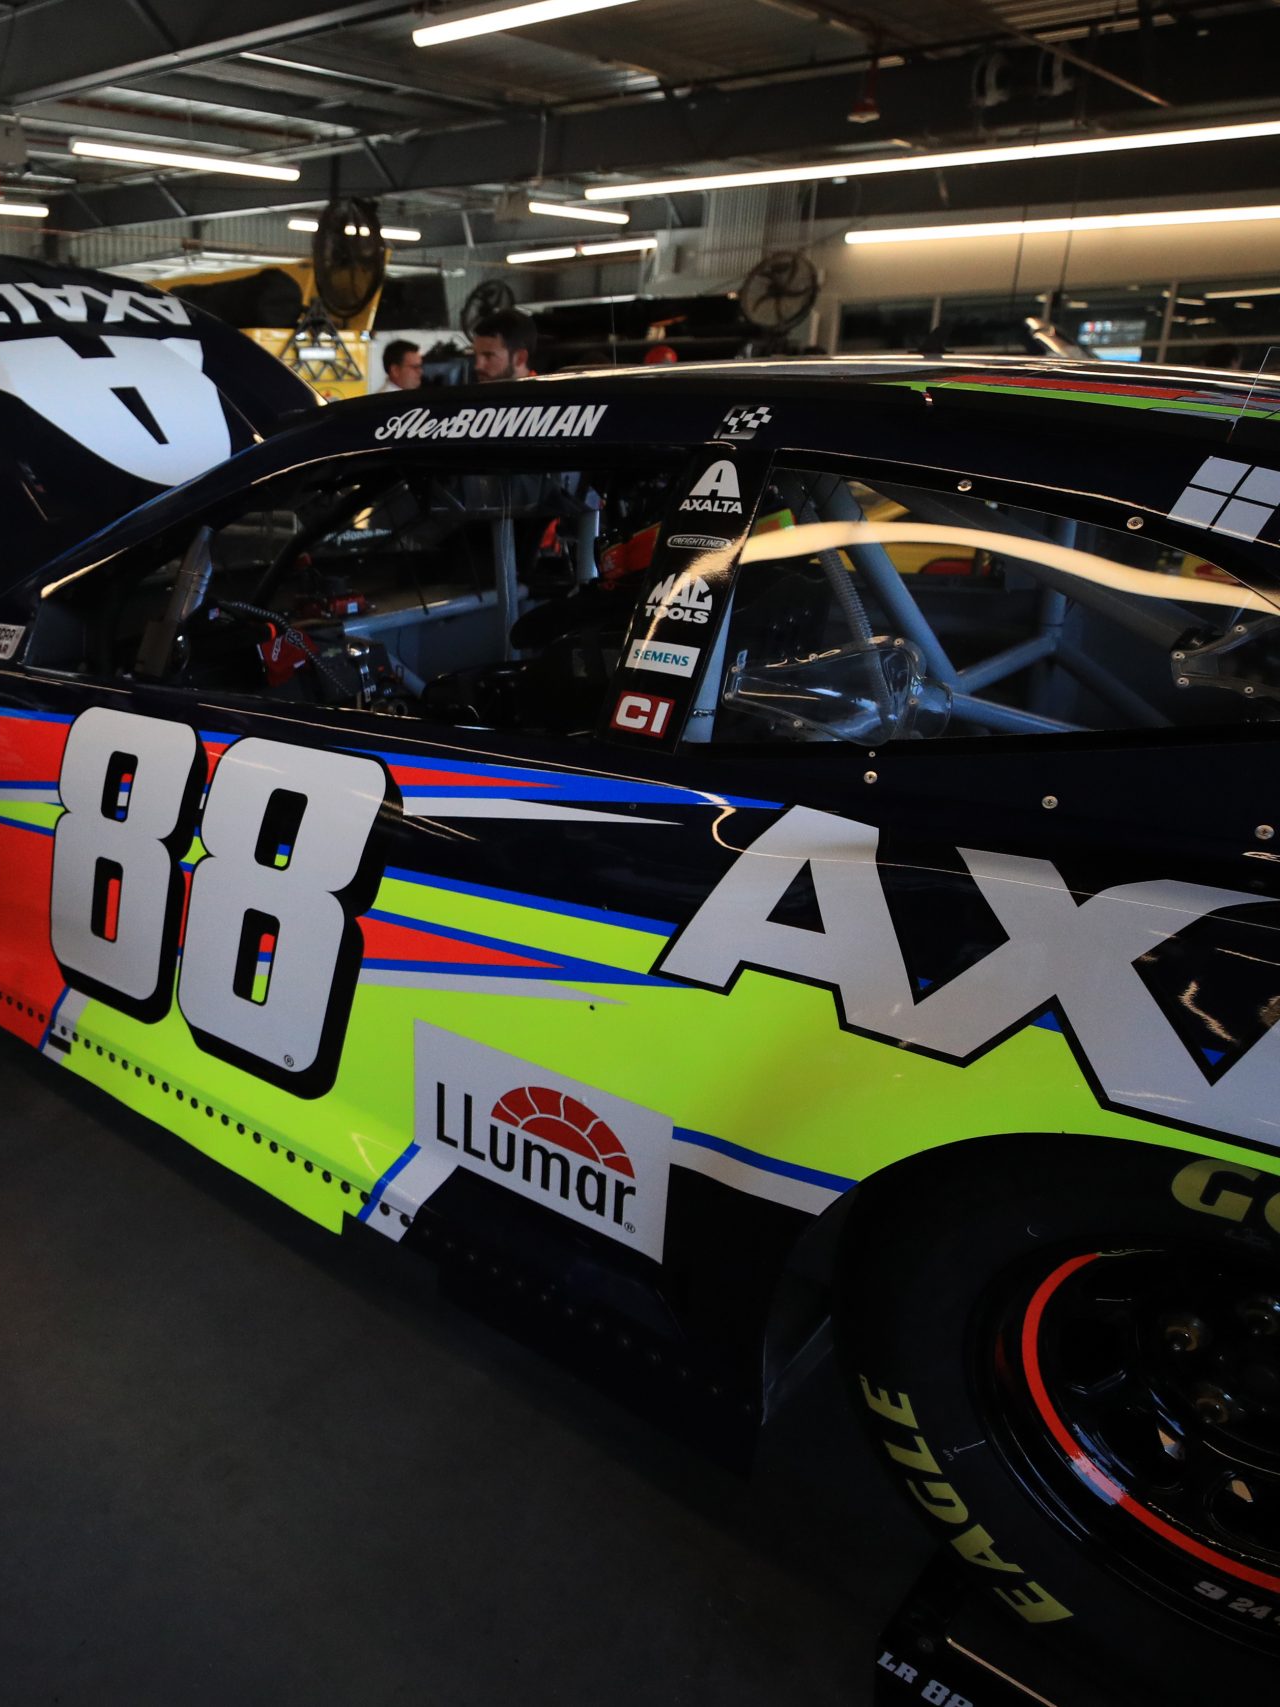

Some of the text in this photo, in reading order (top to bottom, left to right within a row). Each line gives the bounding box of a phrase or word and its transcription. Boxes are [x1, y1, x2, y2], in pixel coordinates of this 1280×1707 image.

[447, 404, 608, 439] BOWMAN
[679, 498, 743, 514] AXALTA
[672, 537, 726, 548] FREIGHTLINER
[647, 571, 713, 610] MAC
[645, 604, 710, 624] TOOLS
[633, 648, 690, 667] SIEMENS
[616, 695, 670, 734] CI
[50, 706, 402, 1095] 88
[654, 804, 1280, 1148] AX
[435, 1081, 637, 1227] LLumar
[857, 1373, 1075, 1624] EAGLE
[1193, 1580, 1273, 1620] 9 24
[877, 1651, 919, 1685] LR
